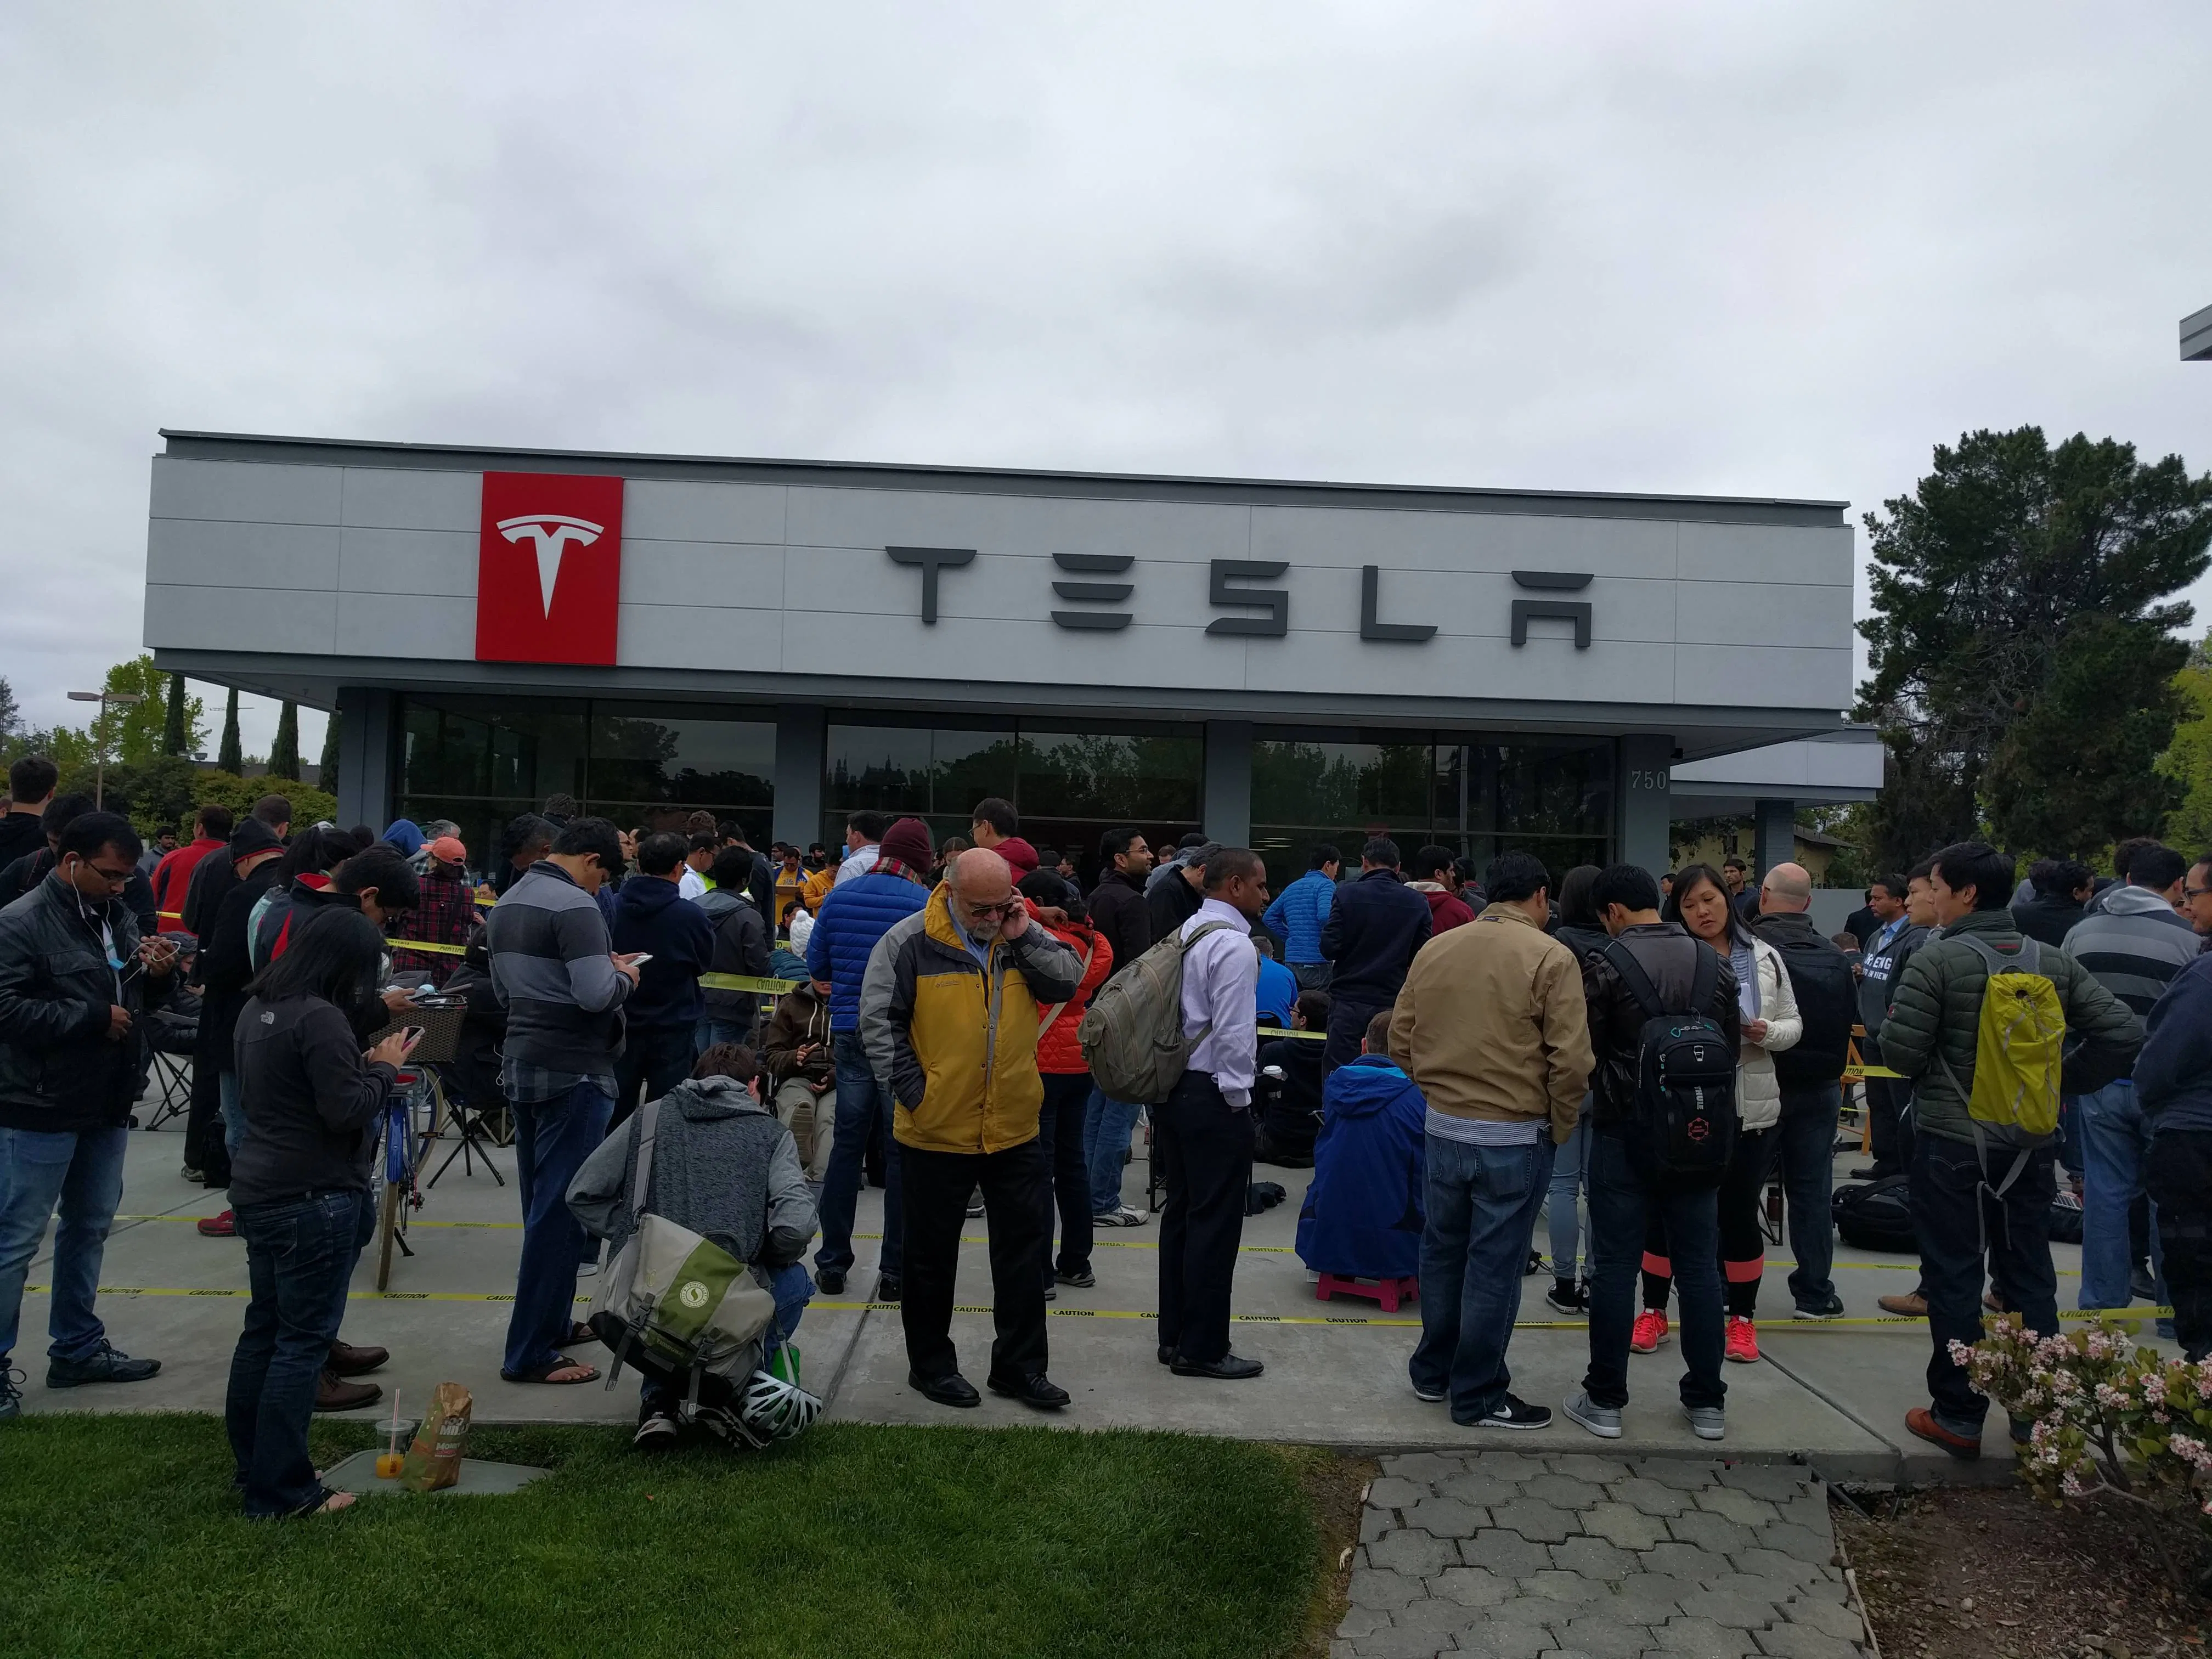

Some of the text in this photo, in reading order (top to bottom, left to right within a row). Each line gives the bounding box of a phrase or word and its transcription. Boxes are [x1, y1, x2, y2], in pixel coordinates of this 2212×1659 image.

[885, 546, 1595, 647] TESLA
[1632, 770, 1666, 789] 750
[1694, 1086, 1703, 1110] THULE
